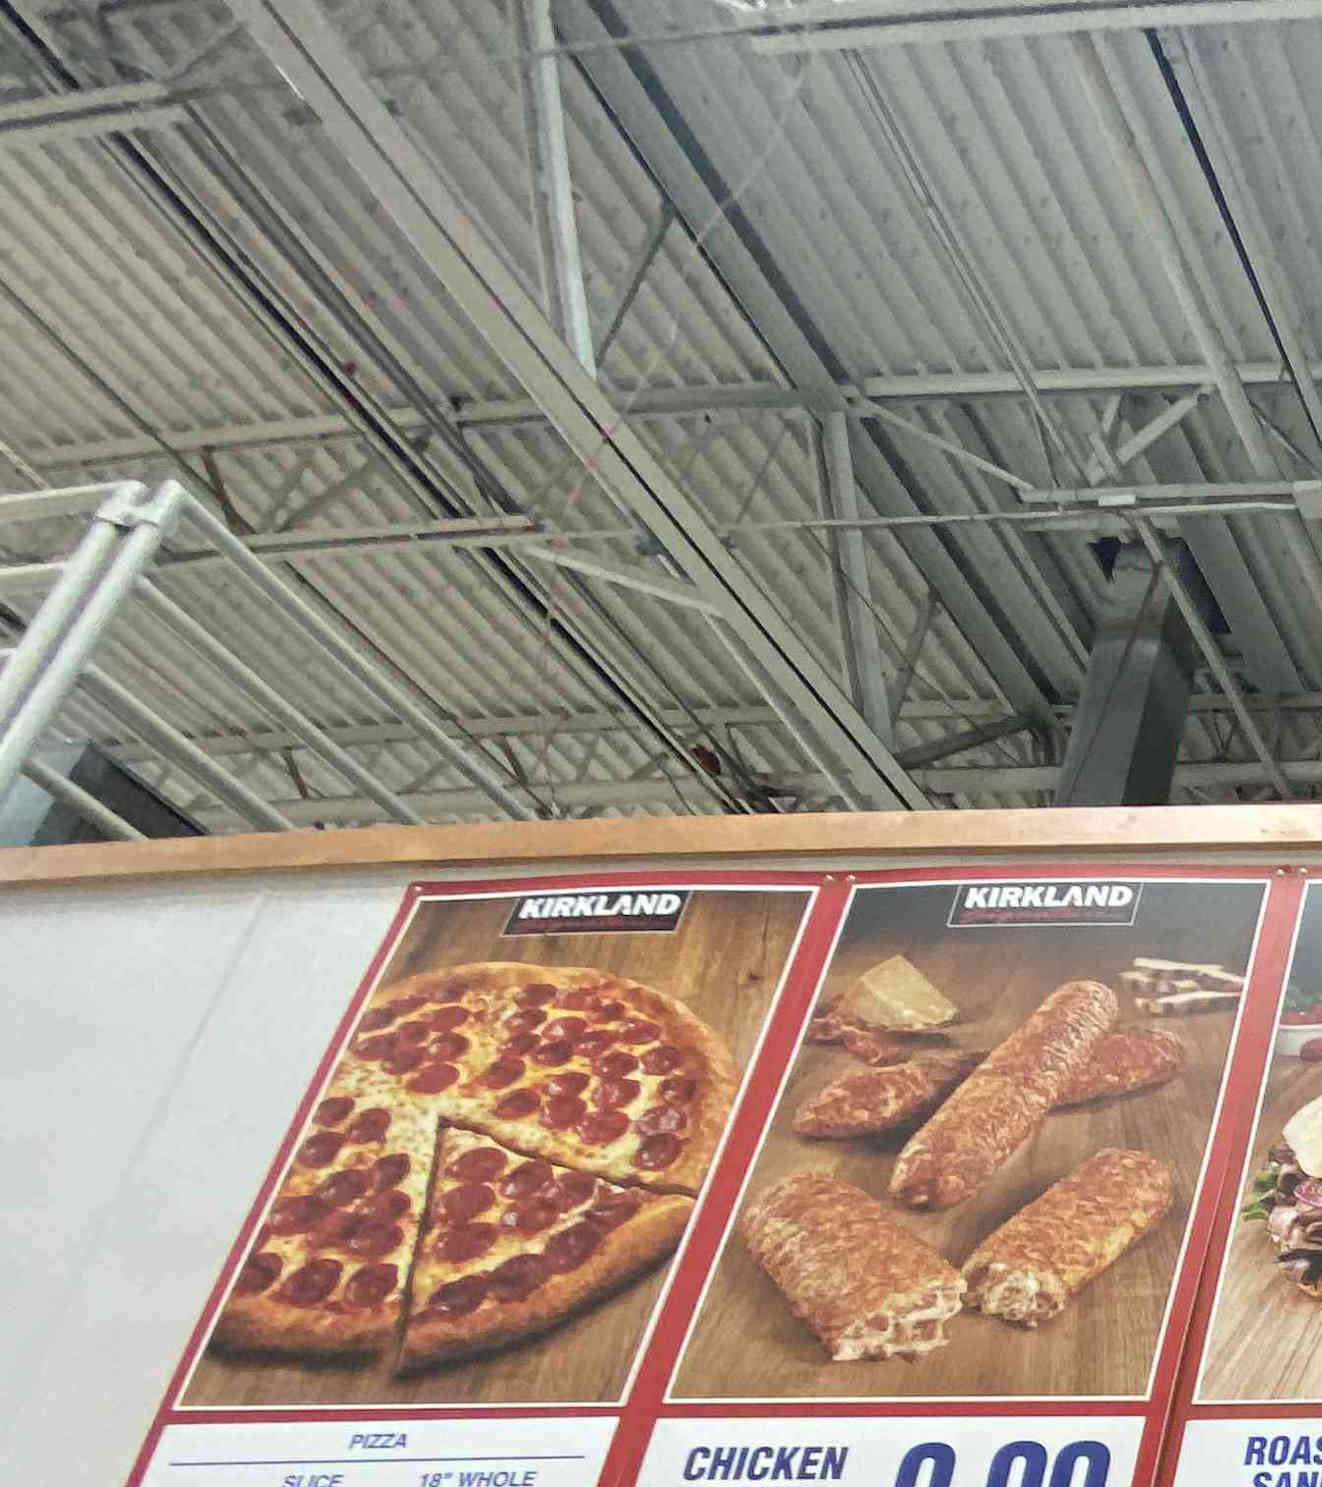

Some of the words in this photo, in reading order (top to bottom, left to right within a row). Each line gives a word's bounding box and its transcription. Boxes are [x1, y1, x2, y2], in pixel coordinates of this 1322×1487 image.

[518, 894, 681, 919] KIRKLAND
[964, 886, 1133, 908] KIRKLAND
[348, 1433, 407, 1450] PIZZA
[683, 1446, 848, 1481] CHICKEN
[457, 1472, 536, 1487] WHOLE
